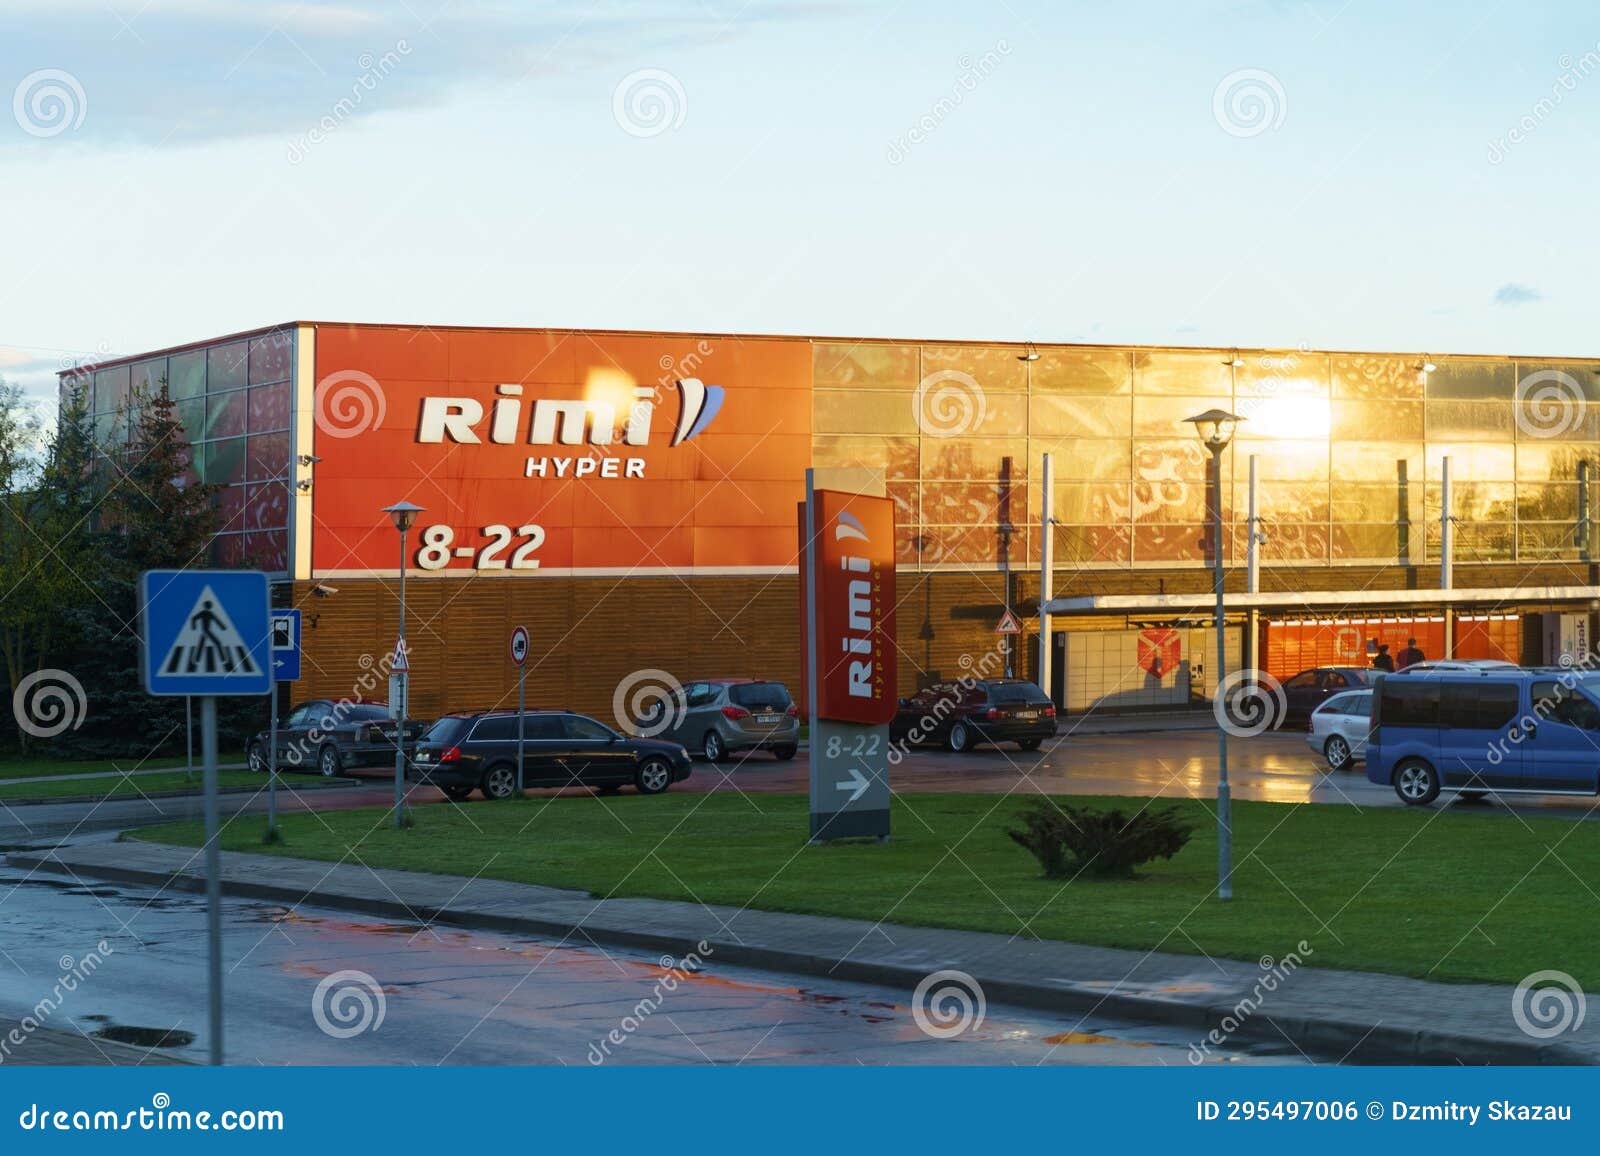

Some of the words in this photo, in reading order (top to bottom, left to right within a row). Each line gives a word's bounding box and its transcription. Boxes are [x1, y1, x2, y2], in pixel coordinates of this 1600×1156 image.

[525, 457, 646, 478] HYPER
[417, 524, 546, 570] 8-22
[825, 734, 880, 759] 8-22
